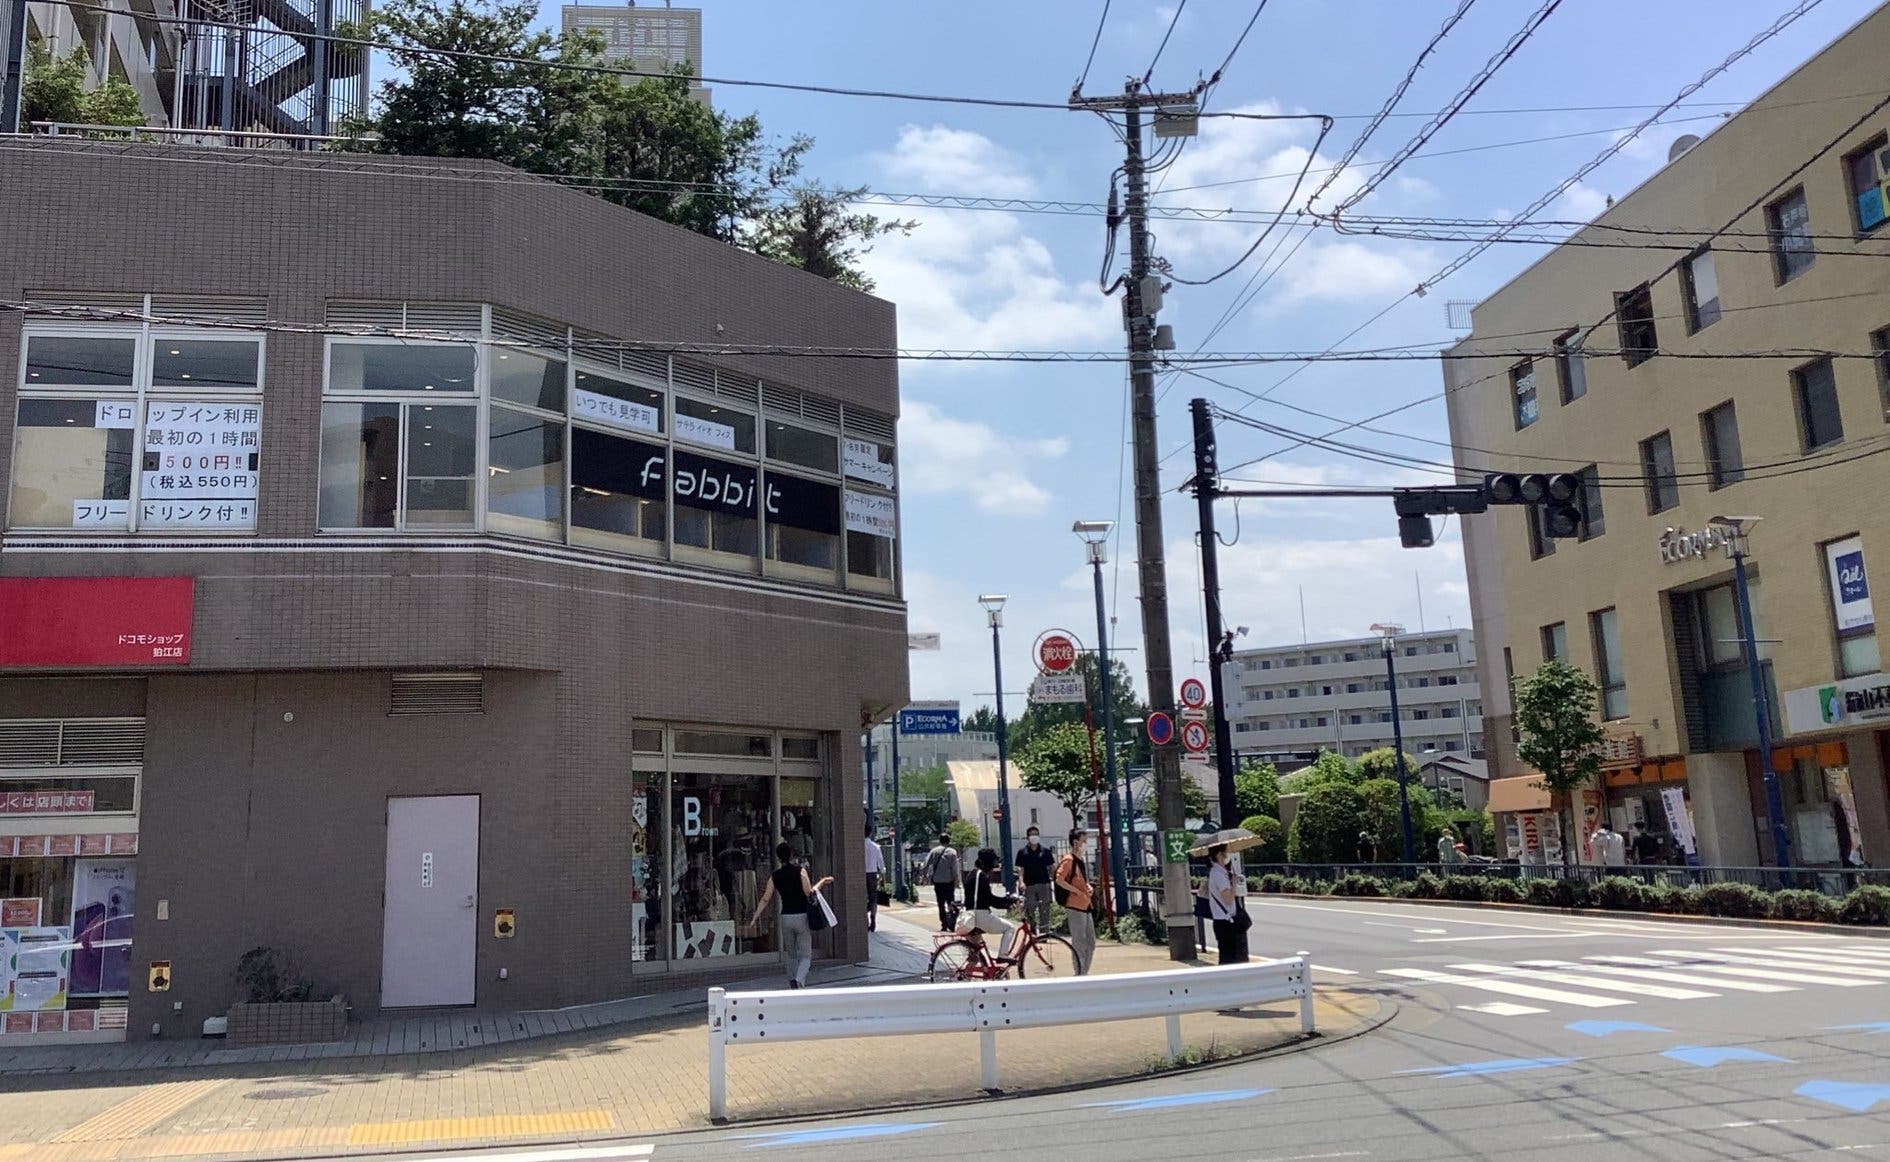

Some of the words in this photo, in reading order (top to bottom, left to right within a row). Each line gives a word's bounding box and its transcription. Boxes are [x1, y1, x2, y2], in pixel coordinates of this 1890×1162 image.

[576, 394, 651, 425] いつでも見学可
[146, 430, 258, 447] 最初の1時間
[149, 474, 258, 491] (税込550円)
[639, 456, 782, 514] fabbit
[118, 634, 184, 645] ドコモショップ
[152, 647, 184, 658] 狛江店
[1043, 646, 1073, 662] 消火栓
[1187, 687, 1201, 701] 40
[1169, 840, 1186, 858] 文
